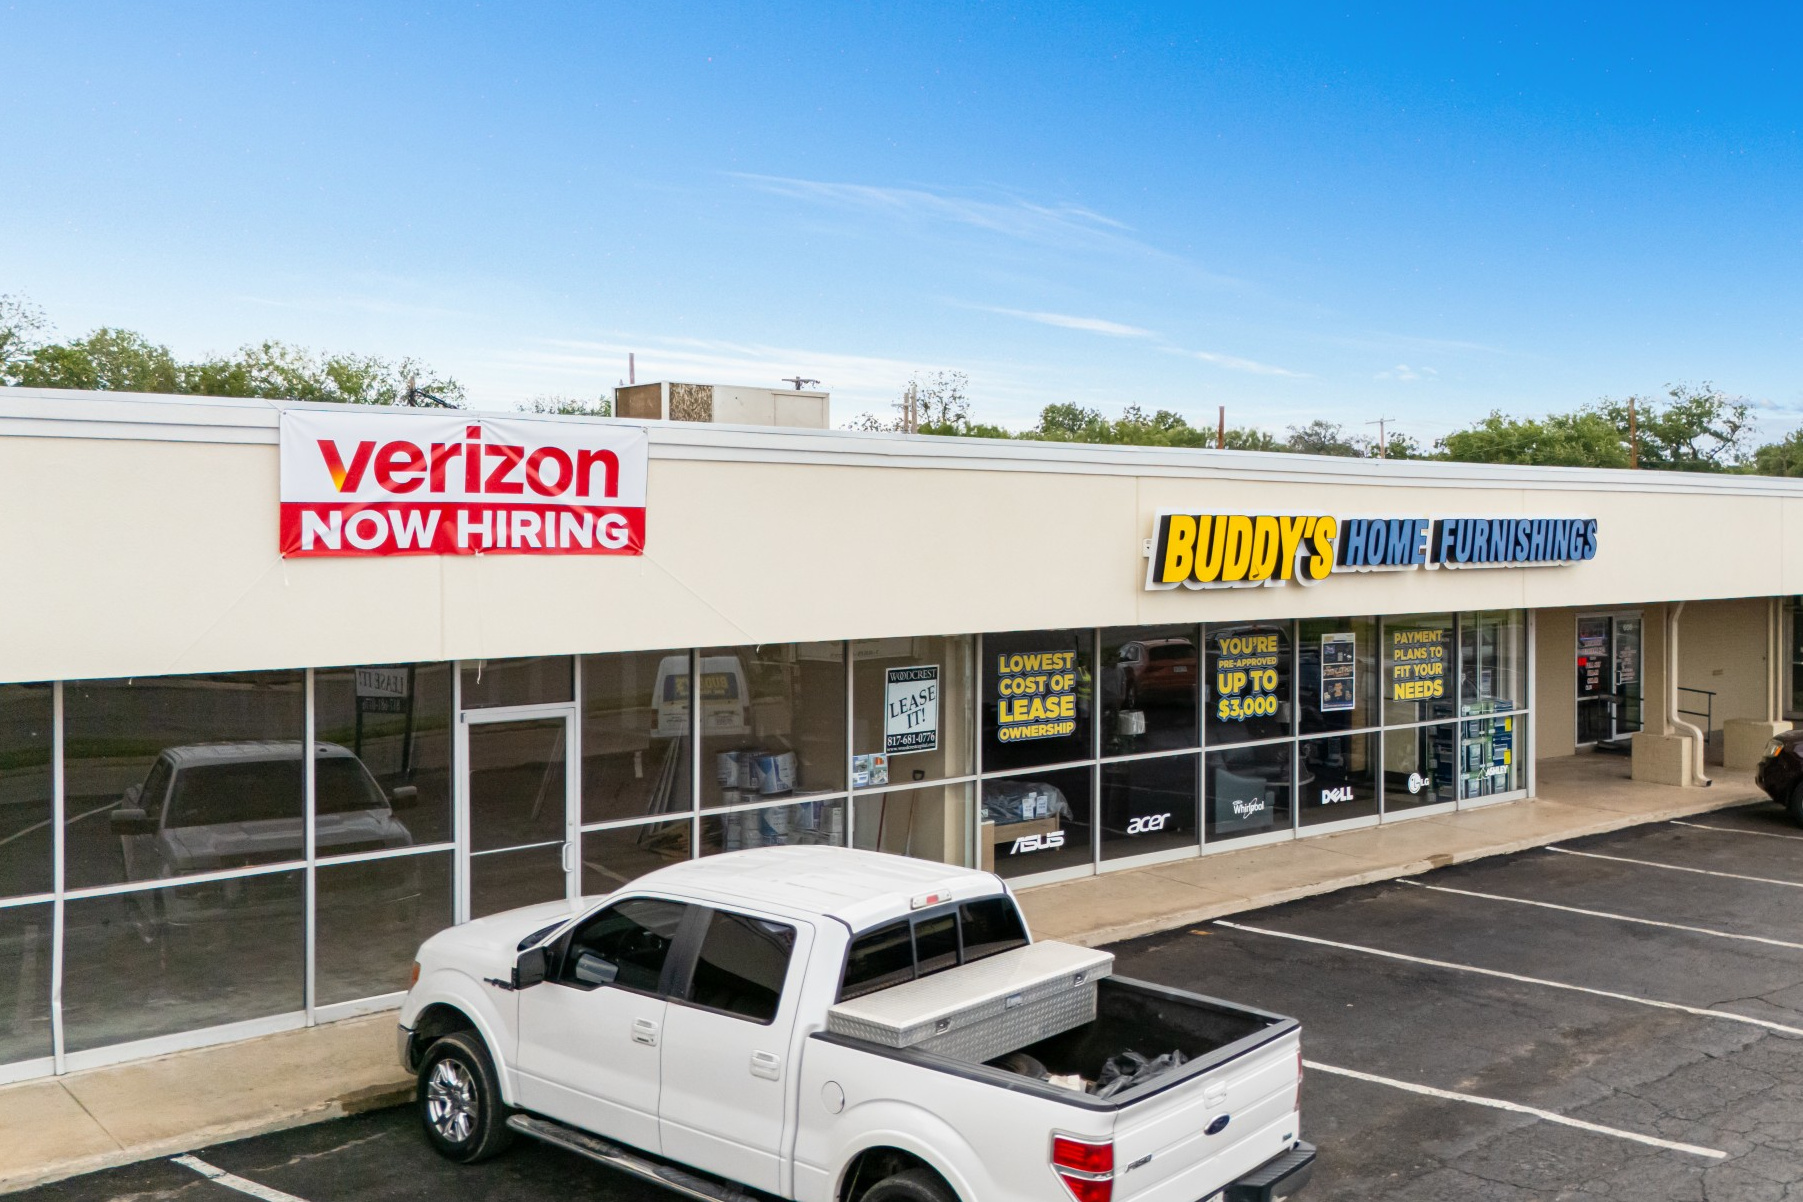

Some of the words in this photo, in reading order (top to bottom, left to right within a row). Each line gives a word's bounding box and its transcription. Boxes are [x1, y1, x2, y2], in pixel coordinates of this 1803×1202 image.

[317, 425, 620, 498] verizon
[301, 509, 442, 551] NOW
[457, 511, 629, 550] HIRING
[1162, 515, 1338, 583] BUDDY'S
[1346, 519, 1429, 565] HOME
[1439, 518, 1598, 563] FURNISHINGS
[1220, 635, 1277, 655] YOU'RE
[1394, 629, 1443, 644] PAYMENT
[1000, 652, 1075, 673] LOWEST
[1218, 656, 1277, 668] PRE-APPROVED
[1394, 647, 1428, 660] PLANS
[1430, 646, 1443, 658] TO
[889, 669, 937, 681] WOODCREST
[1394, 664, 1411, 678] FIT
[1413, 662, 1443, 677] YOUR
[1000, 676, 1047, 695] COST
[1051, 674, 1075, 691] OF
[1218, 671, 1246, 694] UP
[1250, 669, 1277, 691] TO
[1394, 679, 1444, 700] NEEDS
[889, 685, 936, 718] LEASE
[999, 695, 1075, 723] LEASE
[1218, 695, 1277, 719] $3,000
[907, 707, 926, 729] IT!
[887, 732, 935, 746] 817-681-0776
[1000, 721, 1075, 740] OWNERSHIP
[1486, 764, 1509, 776] ASHLEY
[1321, 786, 1354, 805] DELL
[1232, 799, 1266, 816] Whirlpool
[1127, 812, 1171, 834] acer
[1010, 830, 1066, 855] ASUS
